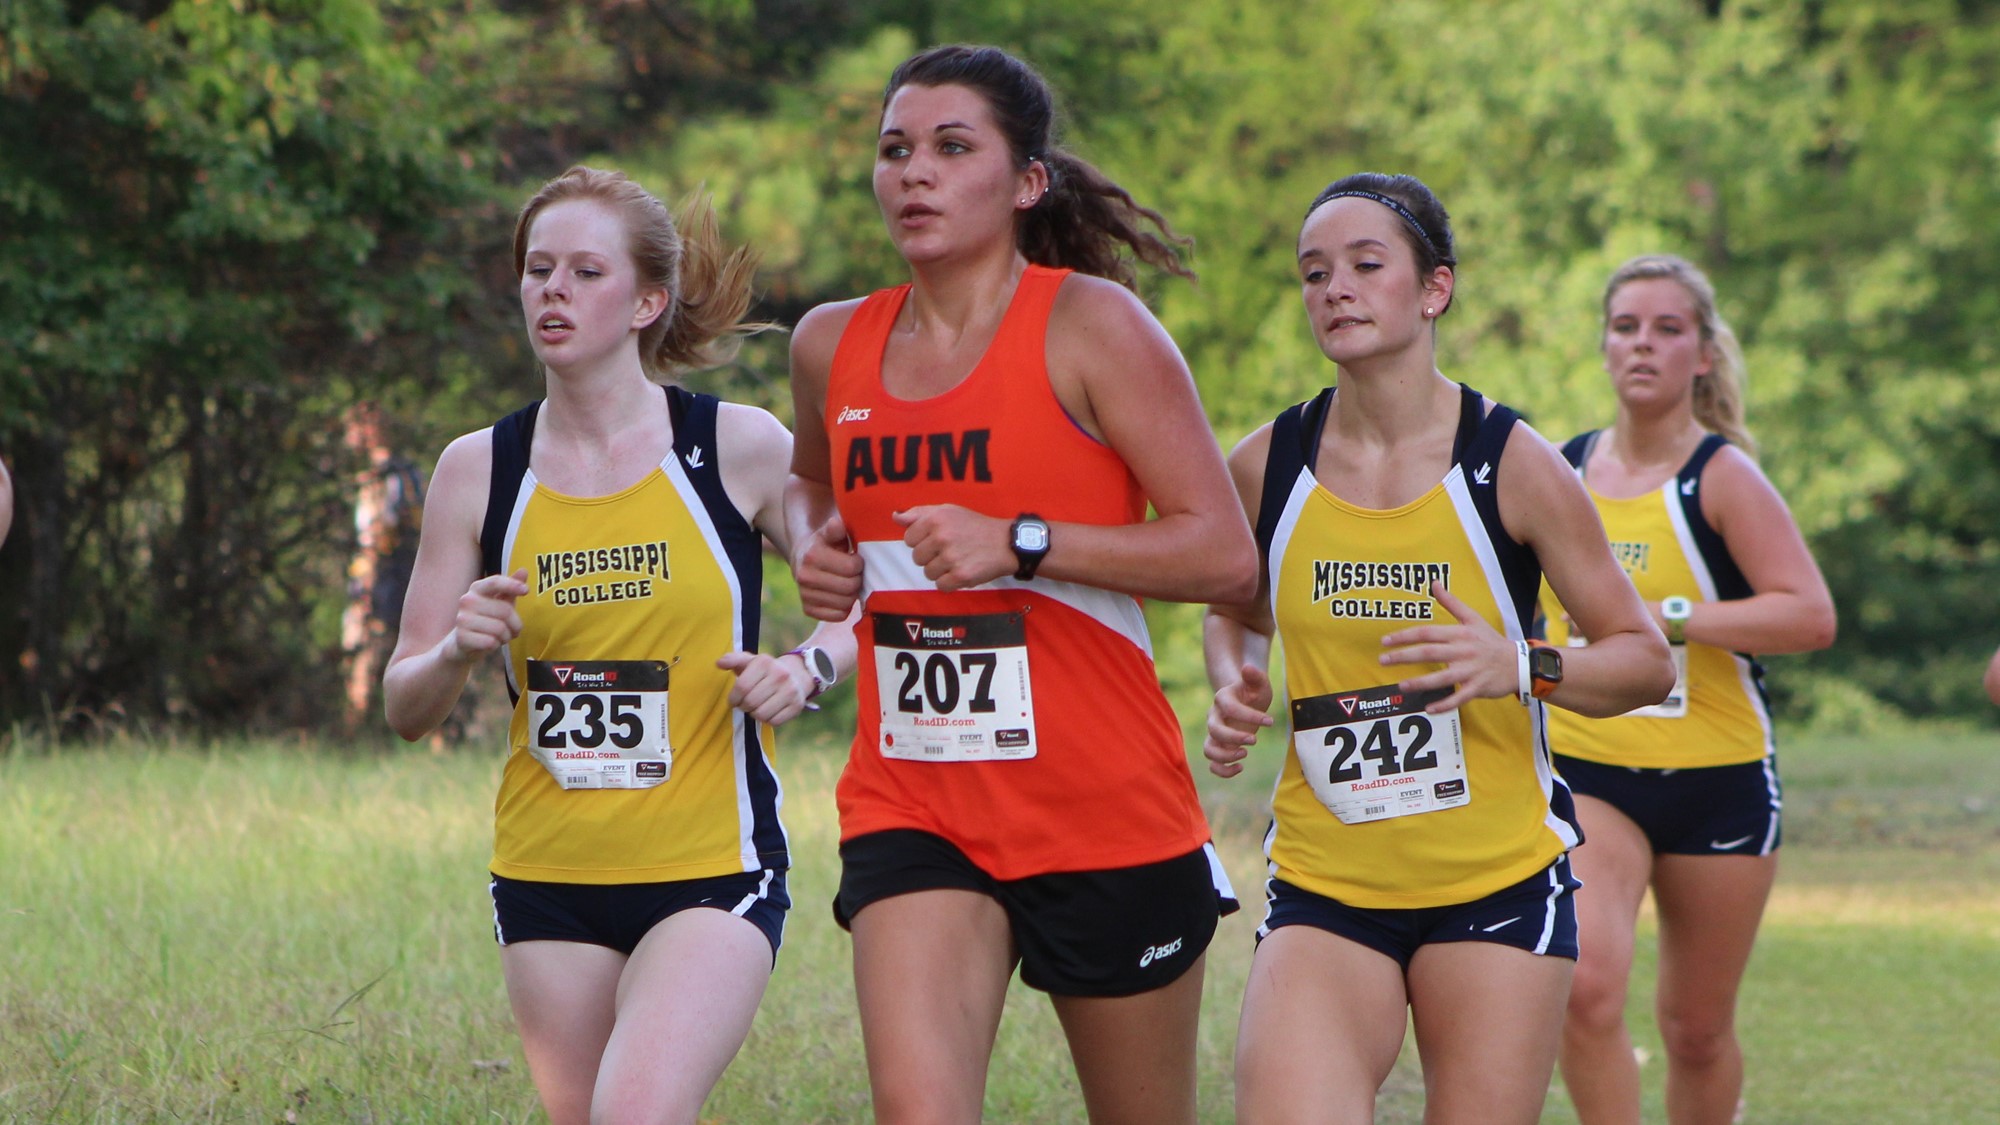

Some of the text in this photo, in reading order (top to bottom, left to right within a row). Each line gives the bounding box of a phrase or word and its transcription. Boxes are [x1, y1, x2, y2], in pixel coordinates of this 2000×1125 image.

[844, 429, 993, 493] AUM
[537, 541, 671, 597] MISSISSIPPI
[1312, 560, 1450, 604] MISSISSIPPI
[554, 579, 652, 607] COLLEGE
[1331, 598, 1433, 620] COLLEGE
[895, 651, 997, 715] 207
[535, 694, 645, 749] 235
[913, 717, 976, 727] RoadID.com
[555, 751, 620, 760] RoadID.com
[1324, 714, 1438, 784] 242
[1351, 775, 1416, 792] RoadID.com
